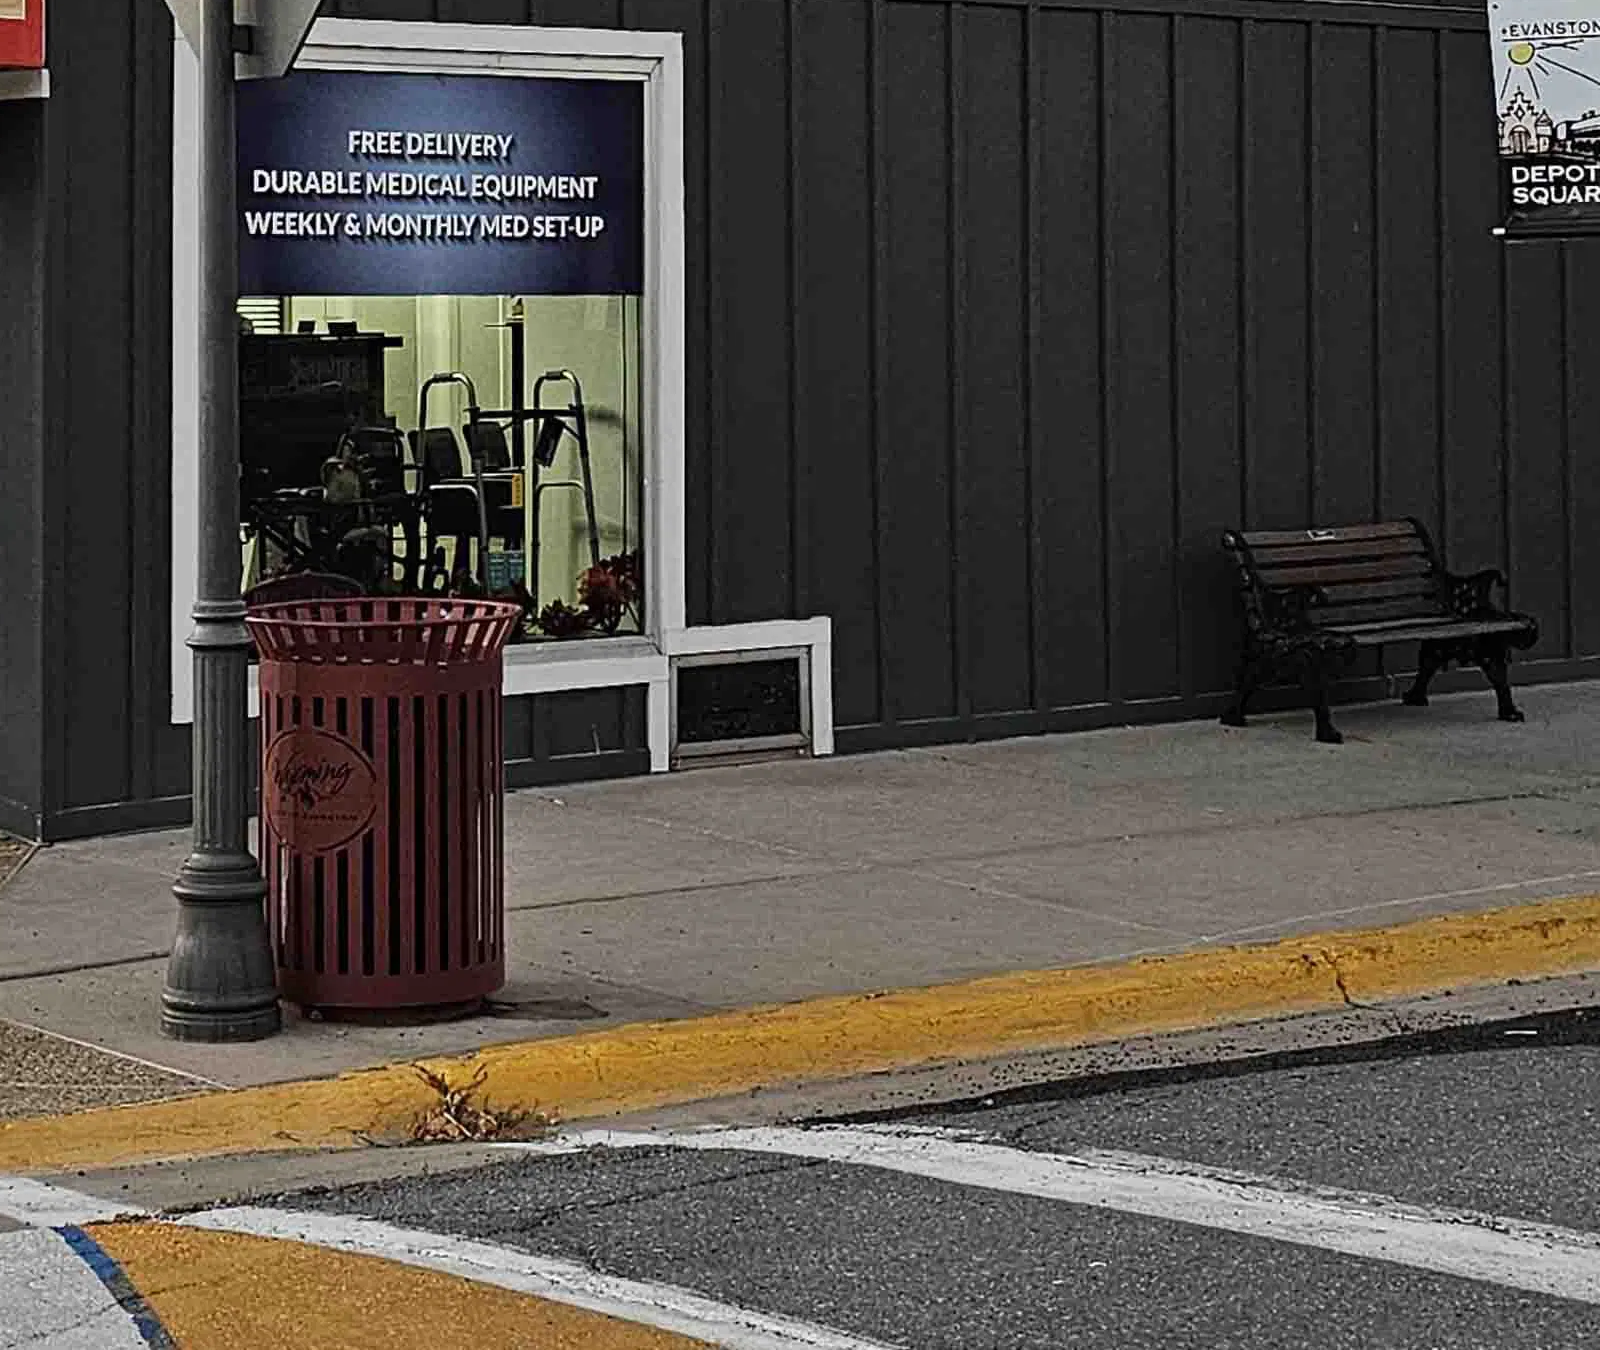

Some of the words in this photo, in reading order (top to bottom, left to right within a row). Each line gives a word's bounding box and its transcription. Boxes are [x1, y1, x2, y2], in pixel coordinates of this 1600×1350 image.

[348, 129, 403, 155] FREE
[406, 132, 514, 158] DELIVERY
[252, 168, 363, 195] DURABLE
[366, 171, 467, 197] MEDICAL
[471, 174, 599, 200] EQUIPMENT
[1512, 164, 1600, 184] DEPOT
[244, 210, 342, 236] WEEKLY
[344, 213, 361, 237] &
[365, 213, 479, 238] MONTHLY
[481, 215, 530, 238] MED
[532, 214, 605, 239] SET-UP
